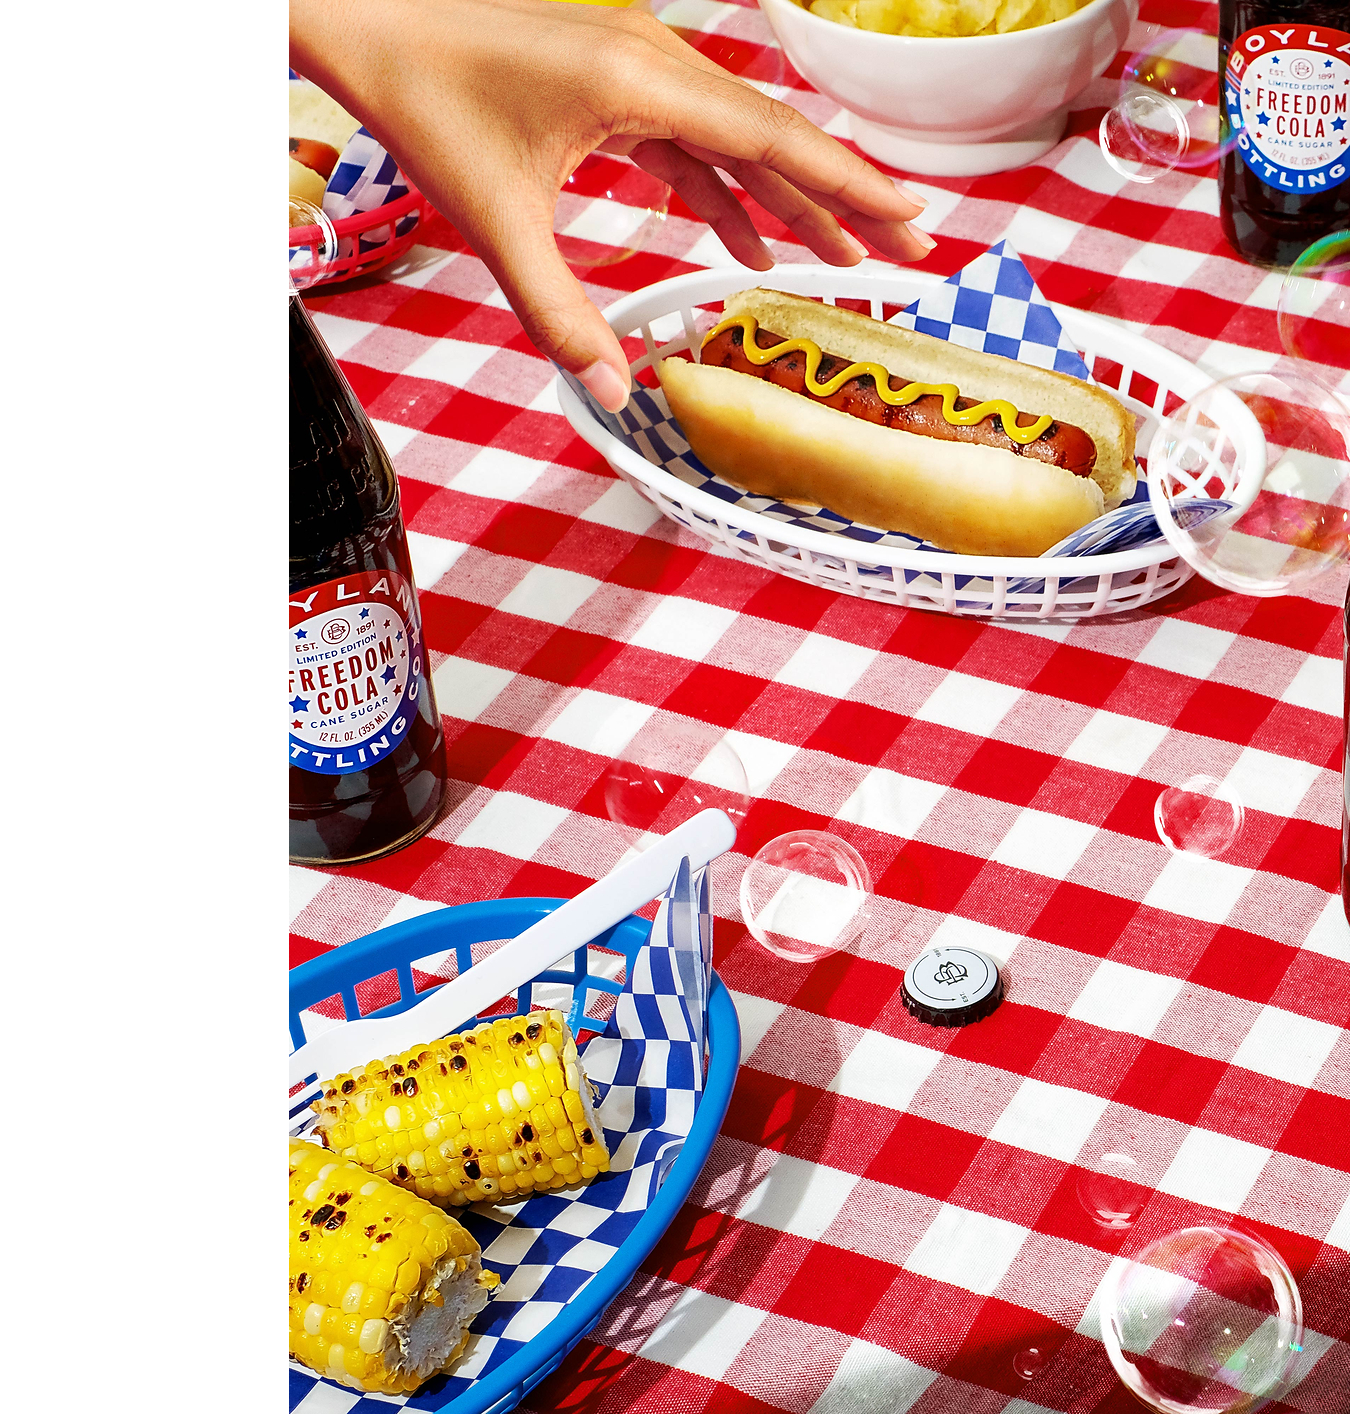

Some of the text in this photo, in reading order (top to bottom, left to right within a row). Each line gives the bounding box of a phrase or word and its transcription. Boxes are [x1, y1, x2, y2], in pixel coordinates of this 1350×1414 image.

[1267, 79, 1335, 91] LIMITED EDITION
[1269, 68, 1287, 78] EST.
[1317, 72, 1336, 80] 1891
[1256, 87, 1347, 116] FREEDOM
[1275, 115, 1326, 138] COLA
[1230, 113, 1347, 188] BOTTLING
[1267, 136, 1333, 148] CANE SUGAR
[355, 619, 376, 636] 1891
[294, 642, 319, 653] EST.
[296, 632, 377, 665] LIMITED EDITION
[289, 635, 395, 693] FREEDOM
[408, 655, 421, 701] CO
[317, 675, 379, 716] COLA
[310, 696, 389, 730] CANE SUGAR
[318, 710, 389, 743] 12 FL. OZ. (355 ML)
